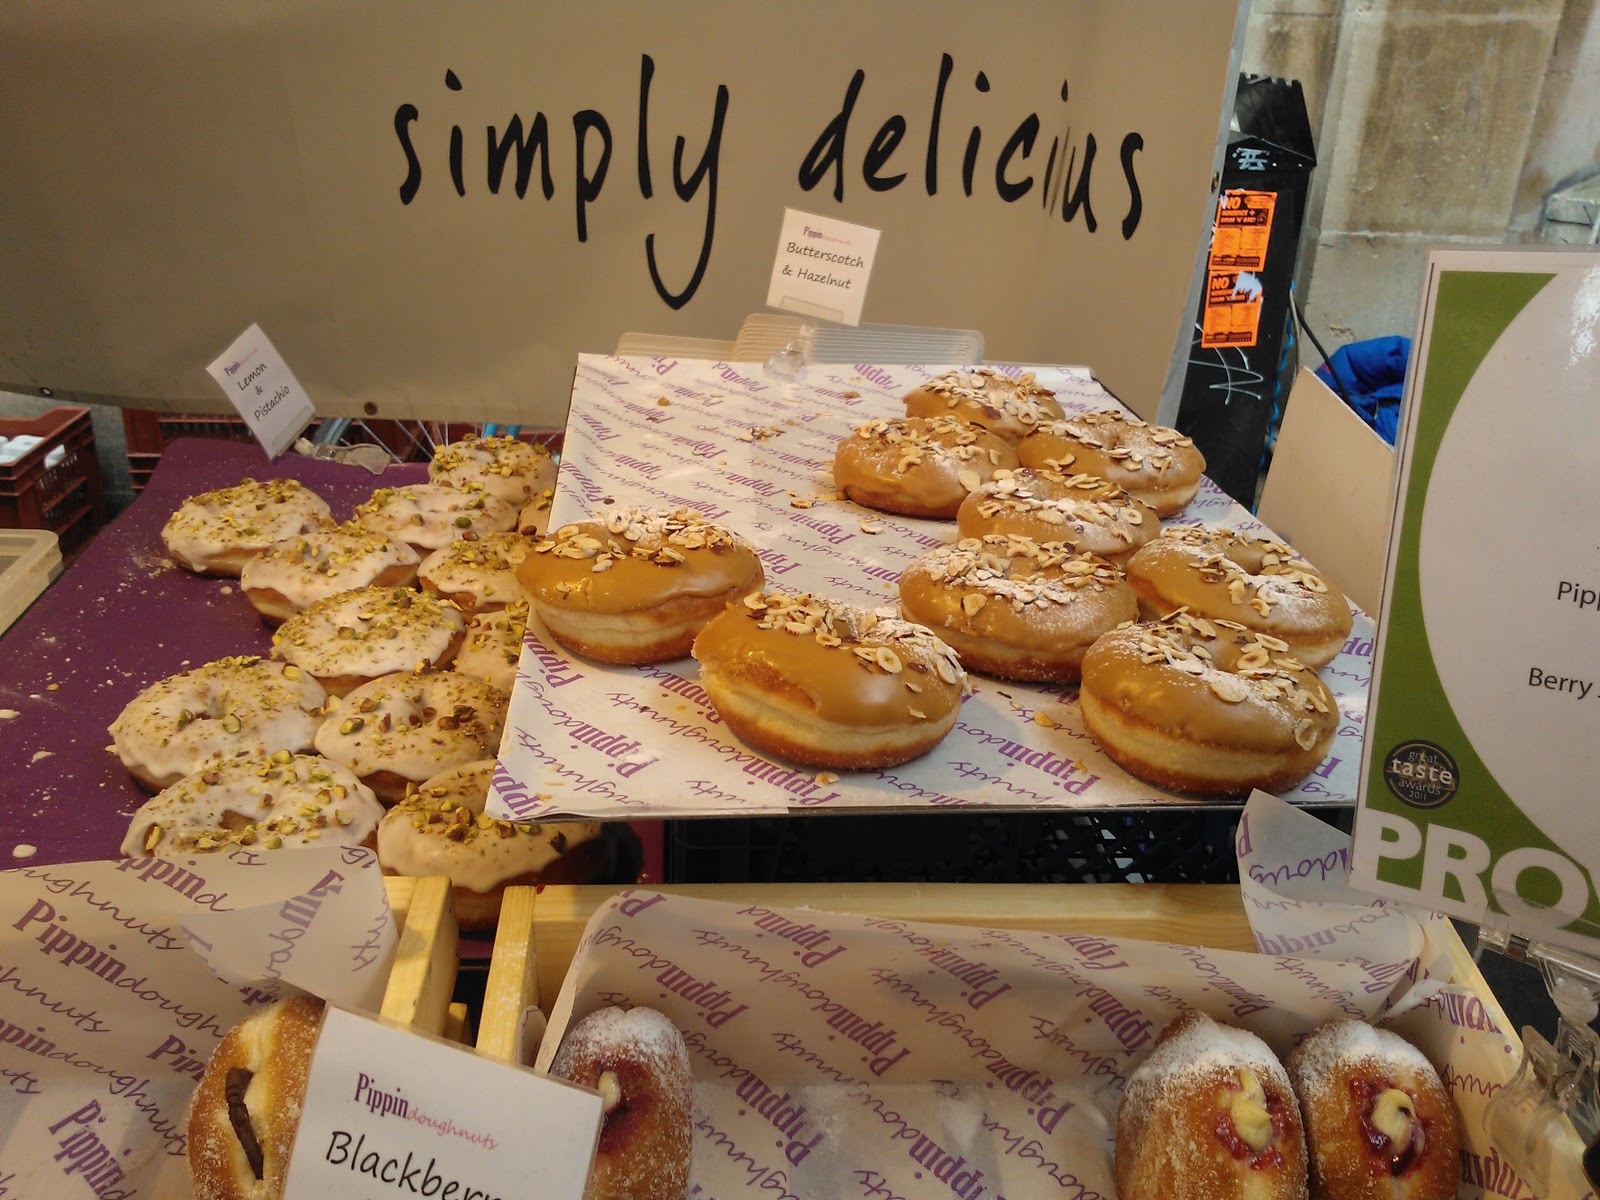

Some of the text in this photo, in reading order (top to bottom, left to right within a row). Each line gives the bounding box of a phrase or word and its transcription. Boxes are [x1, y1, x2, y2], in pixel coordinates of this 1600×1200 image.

[394, 53, 729, 310] simply
[786, 241, 864, 268] Butterscotch
[782, 265, 852, 289] & Hazelnut
[237, 363, 267, 391] Lemon
[256, 385, 263, 395] &
[254, 385, 290, 421] Pistachio
[1557, 581, 1600, 612] Pip
[1528, 667, 1593, 700] Berry
[1391, 757, 1453, 785] taste
[1408, 750, 1439, 764] great
[1397, 779, 1441, 795] awards
[1352, 807, 1595, 936] PRO
